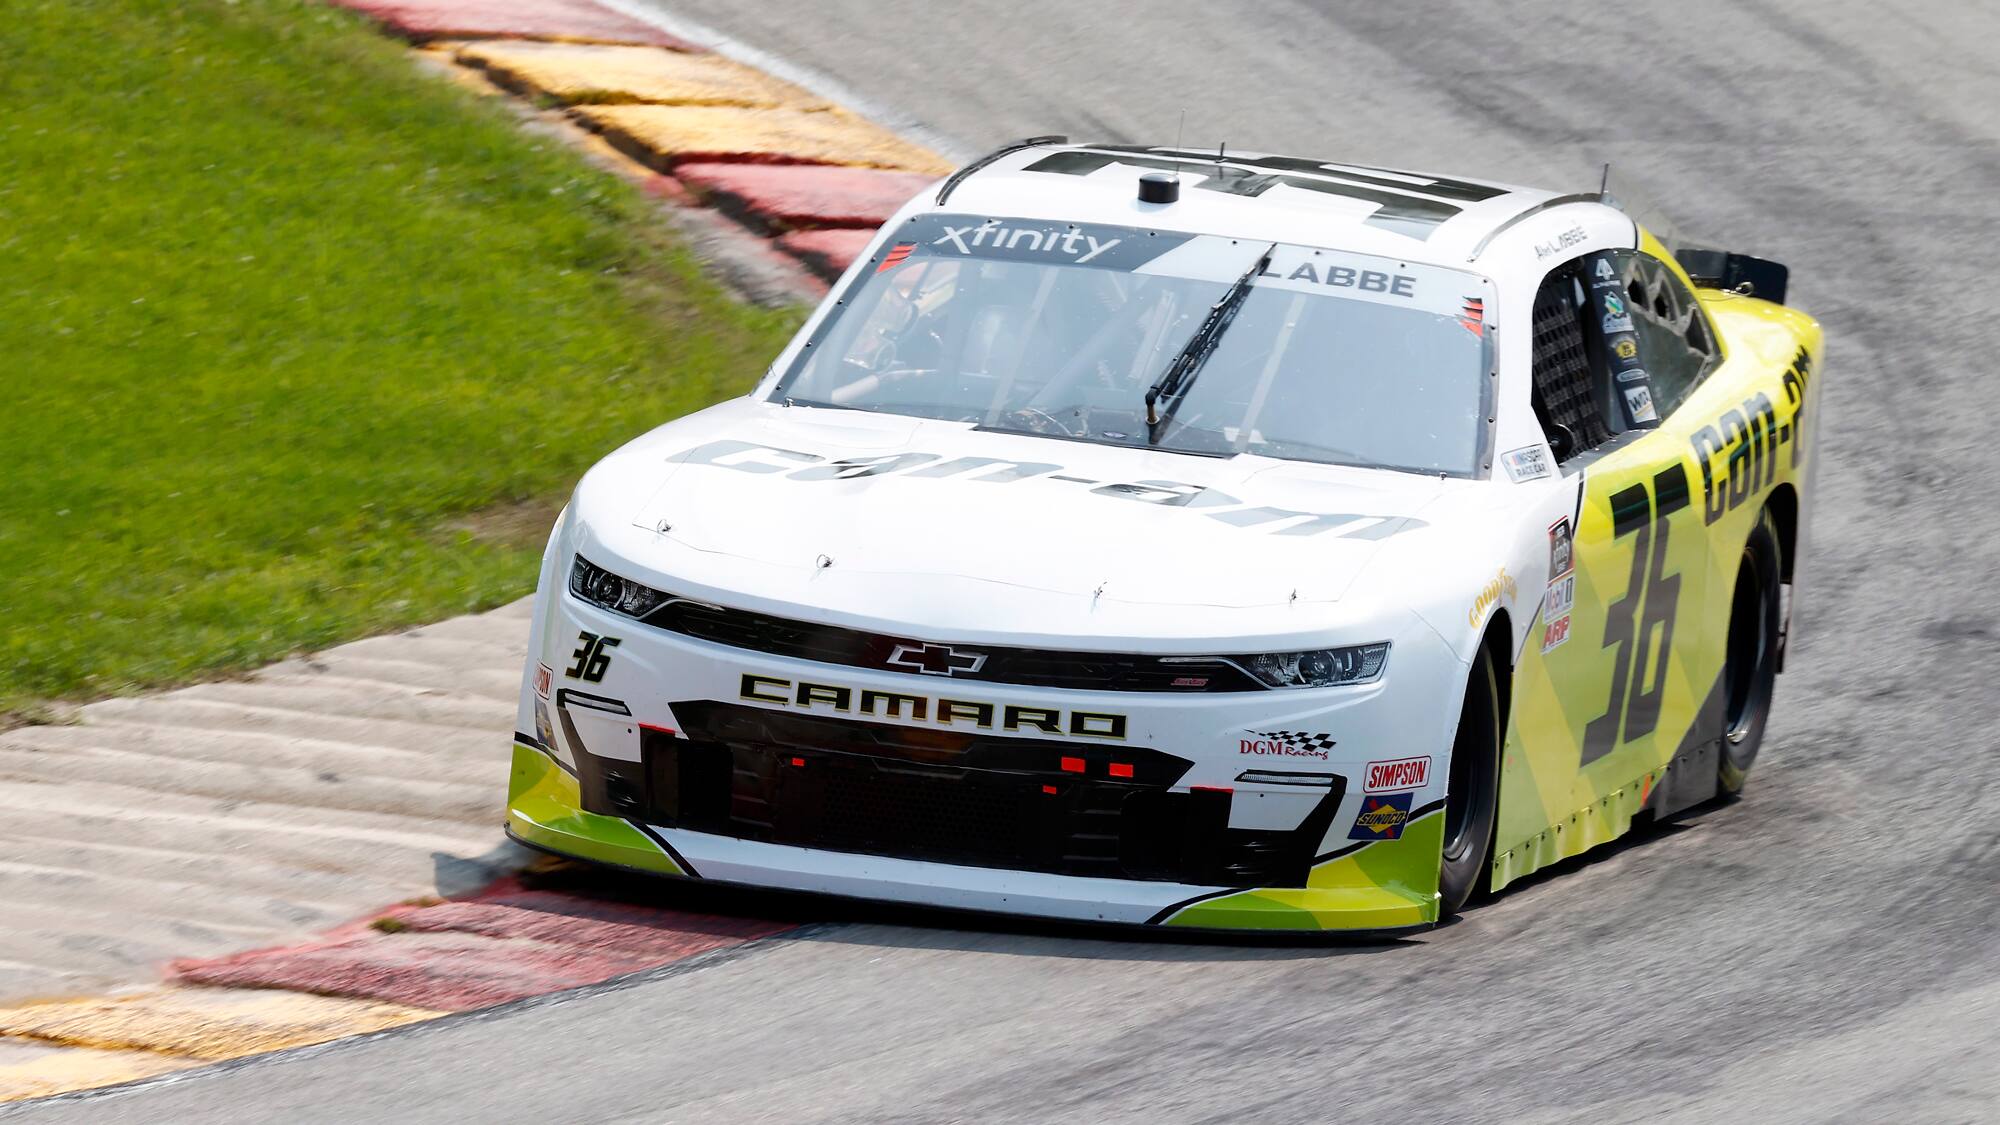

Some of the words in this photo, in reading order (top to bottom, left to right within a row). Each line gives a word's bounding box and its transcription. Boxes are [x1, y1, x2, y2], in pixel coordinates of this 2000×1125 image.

[934, 219, 1121, 263] xfinity
[1258, 257, 1417, 298] LABBE
[666, 439, 1431, 541] can-am
[1543, 616, 1569, 649] ARP
[1579, 462, 1690, 768] 36
[564, 630, 623, 684] 36
[740, 673, 1128, 740] CAMARO
[1240, 739, 1283, 756] DGM
[1284, 745, 1329, 761] Racing
[1369, 760, 1428, 789] SIMPSON
[1359, 811, 1406, 826] SUNOCO
